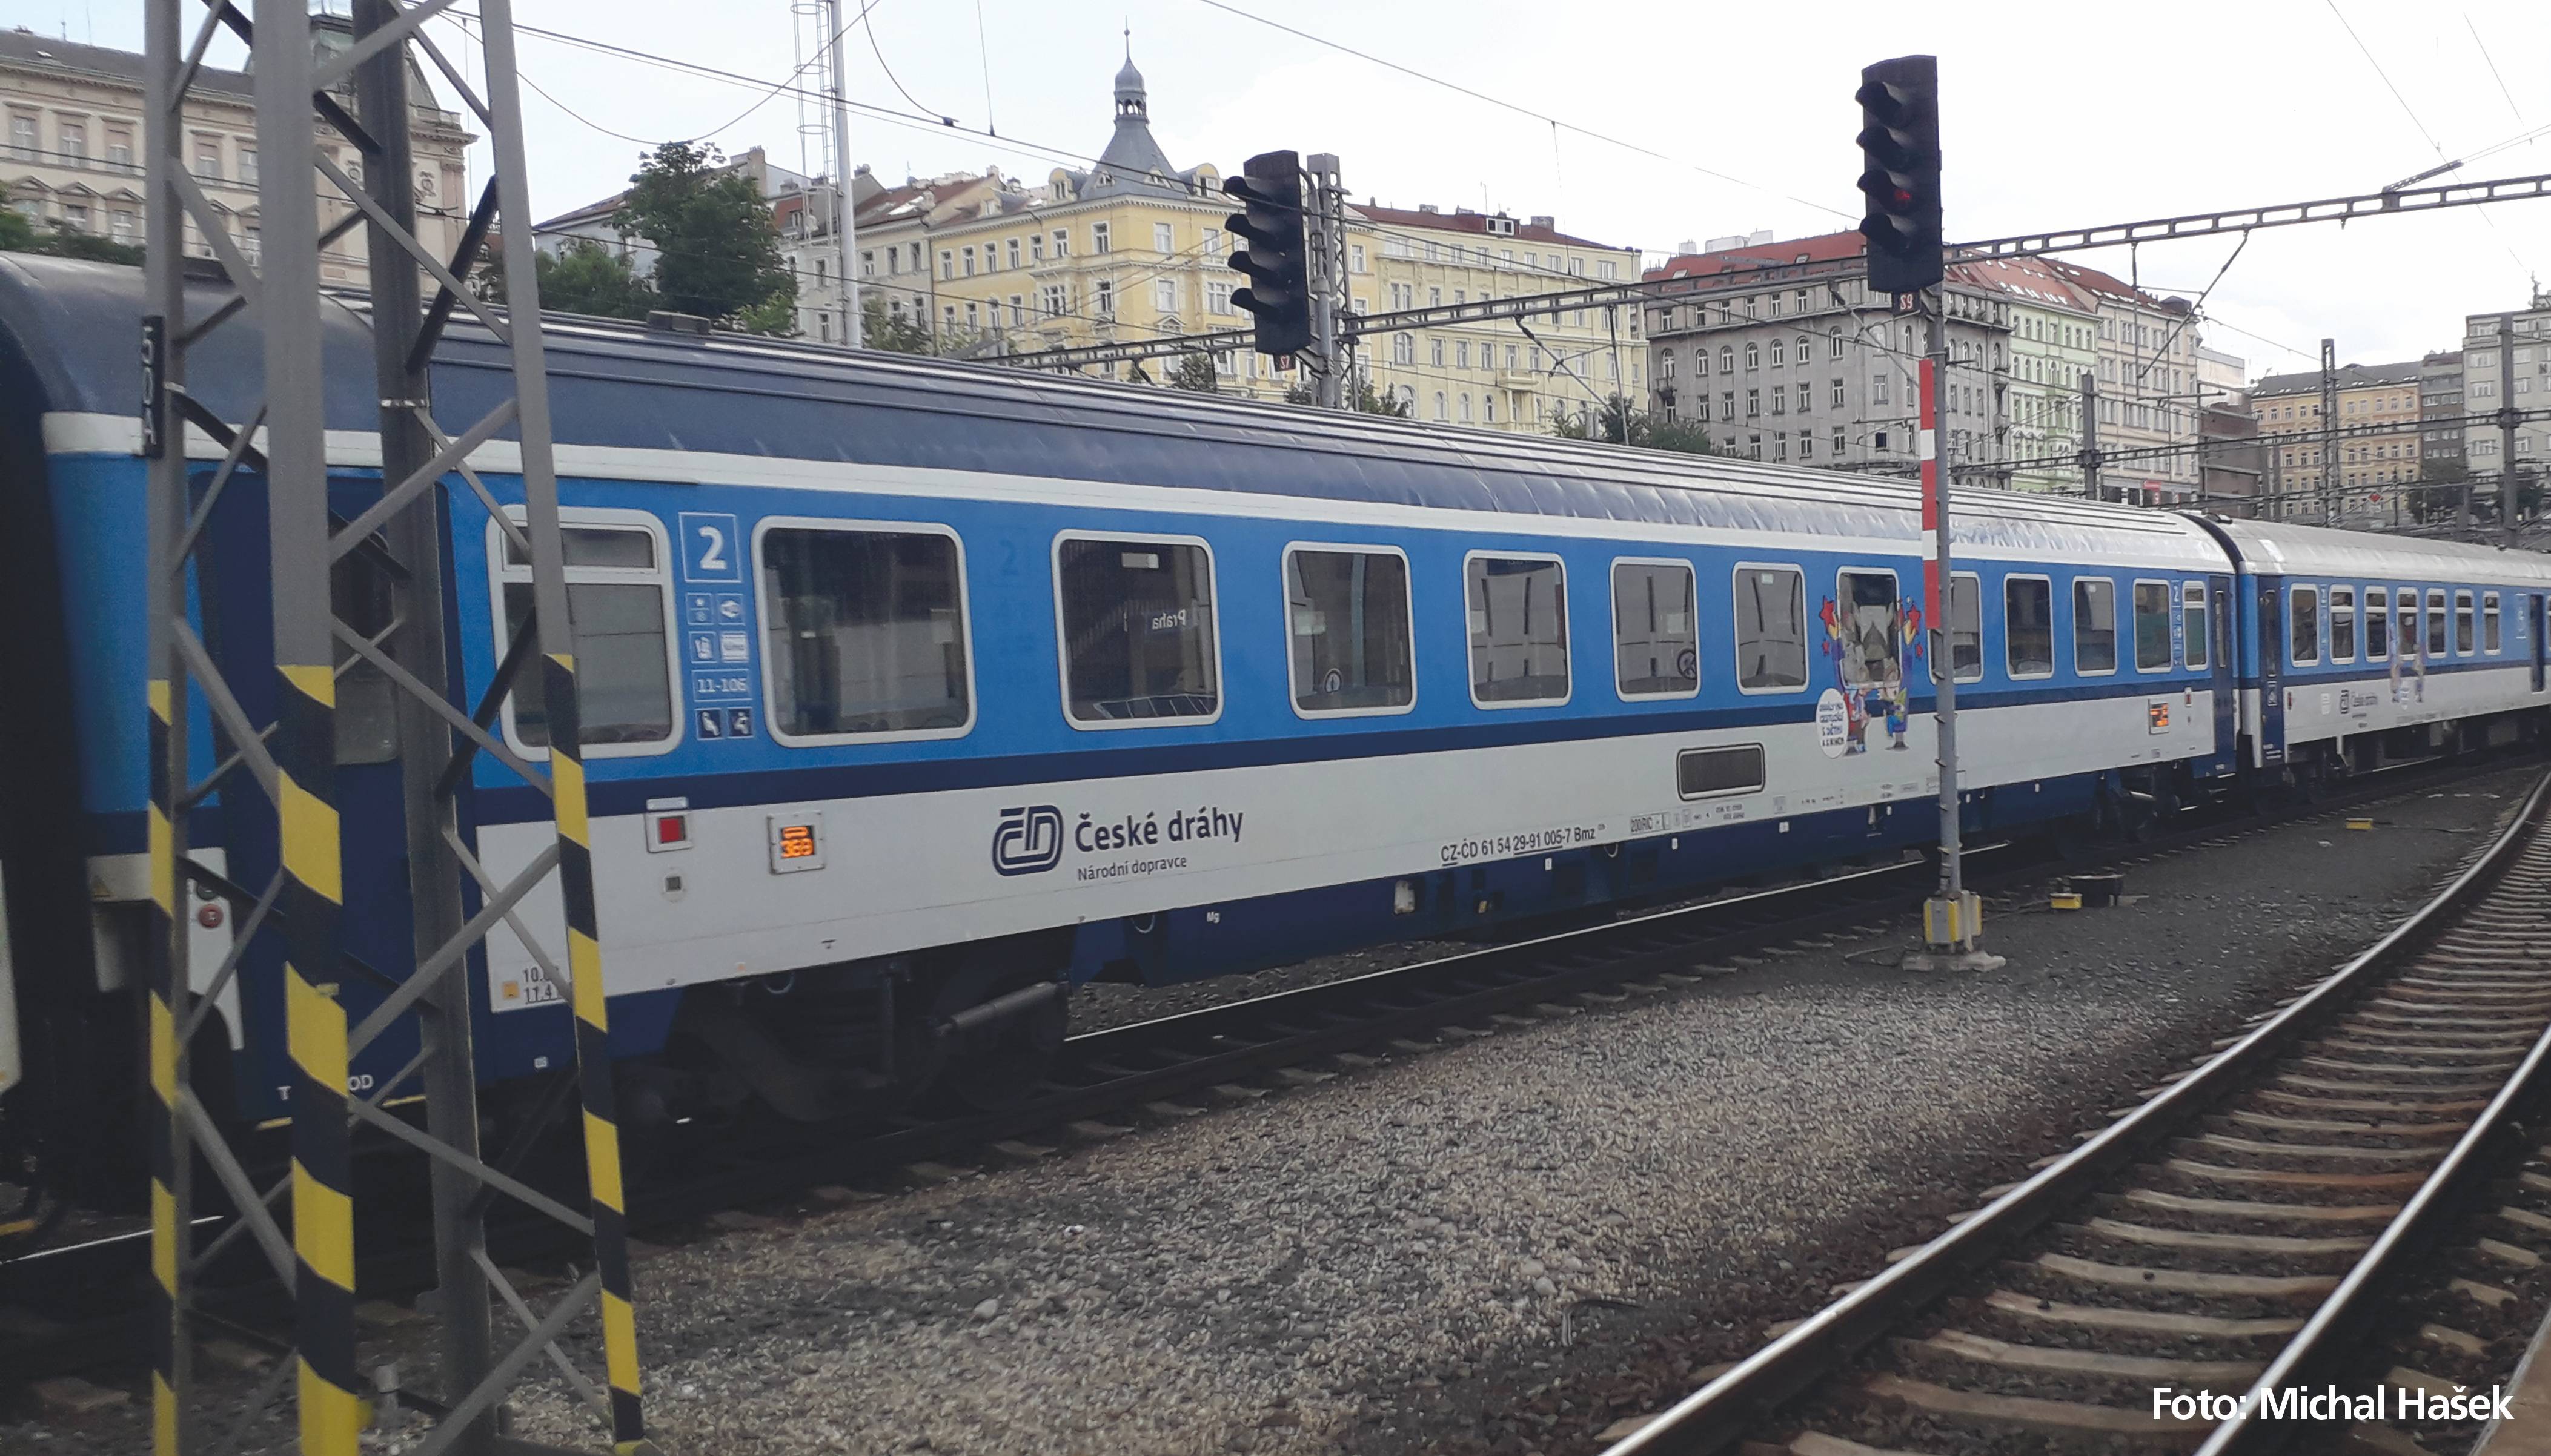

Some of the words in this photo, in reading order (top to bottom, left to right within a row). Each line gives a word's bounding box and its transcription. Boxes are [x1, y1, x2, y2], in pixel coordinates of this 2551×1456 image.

[1900, 294, 1912, 309] S9
[697, 526, 728, 570] 2
[1075, 812, 1159, 852] České
[1168, 806, 1244, 843] dráhy
[1482, 839, 1493, 855] 61
[1498, 836, 1510, 853] 54
[1513, 832, 1541, 852] 29-91
[1544, 828, 1571, 846] 005-7
[1574, 827, 1596, 842] Bmz
[1078, 860, 1129, 881] Národní
[1132, 855, 1187, 875] dopravce
